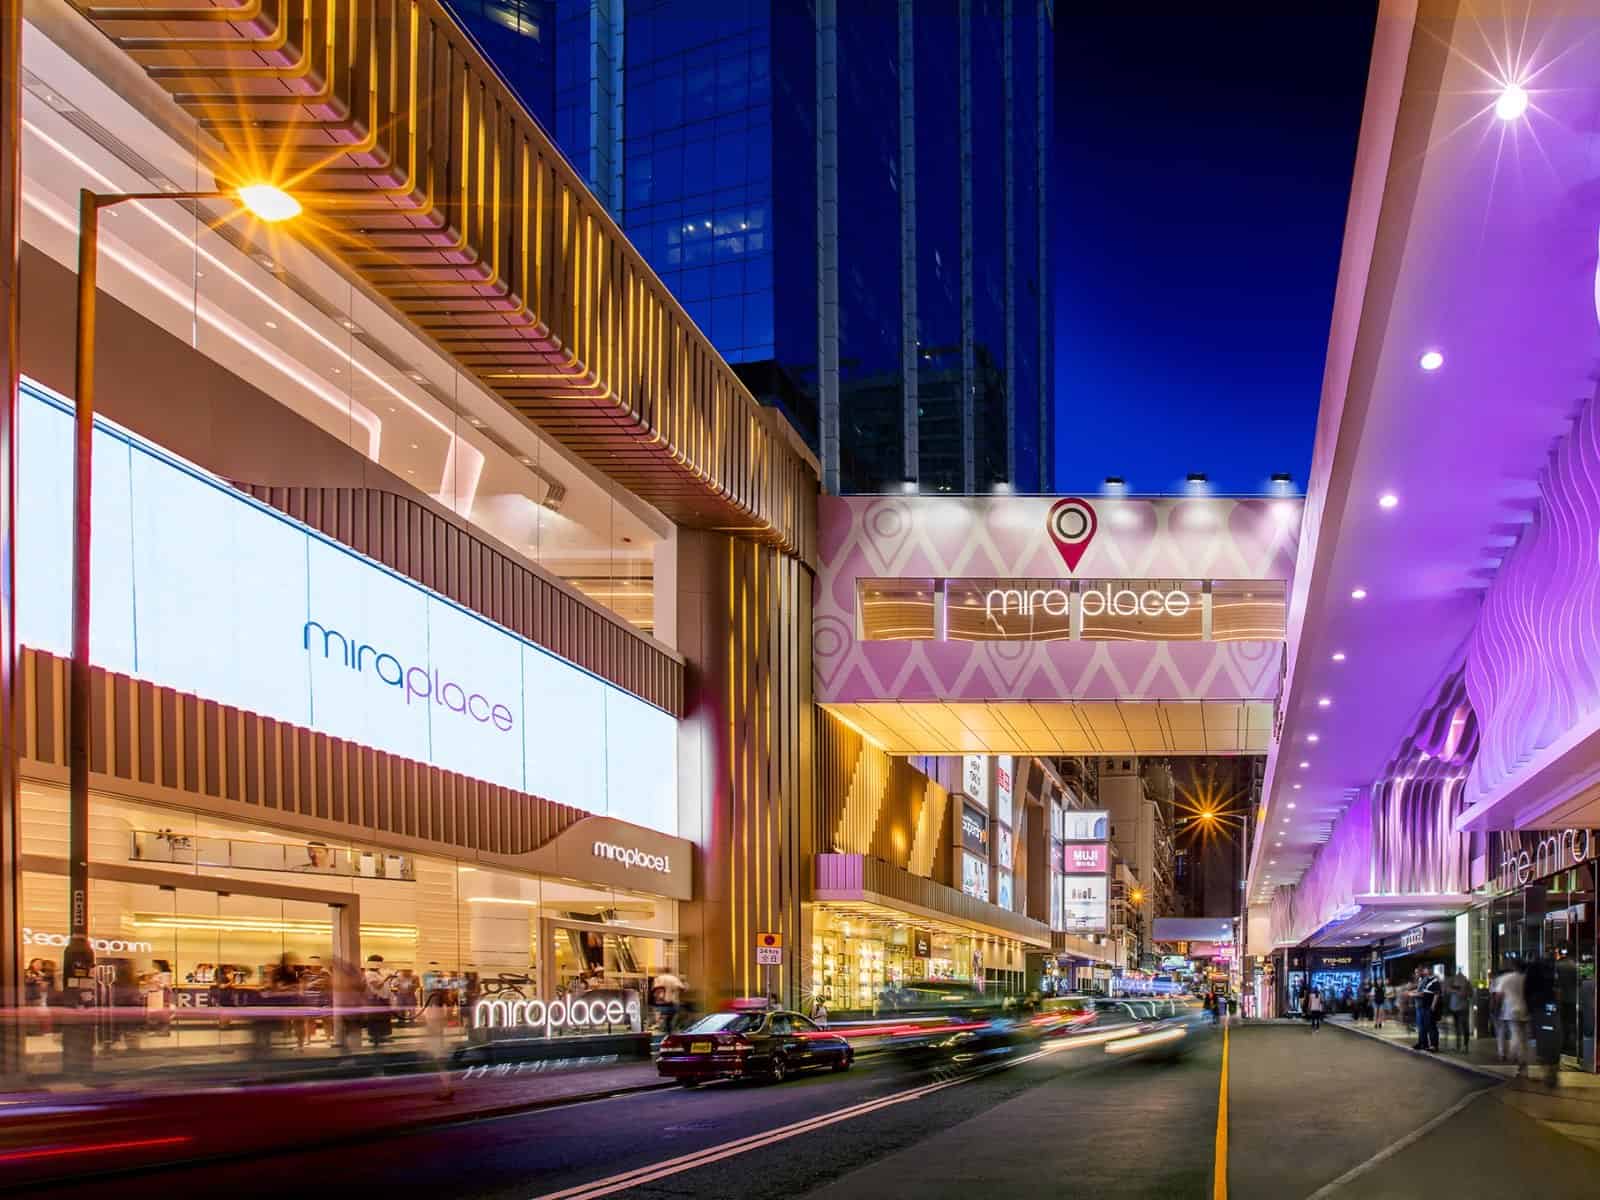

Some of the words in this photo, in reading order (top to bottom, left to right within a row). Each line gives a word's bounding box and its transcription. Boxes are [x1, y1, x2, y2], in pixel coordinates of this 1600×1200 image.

[986, 589, 1069, 617] mira
[1080, 583, 1190, 632] place
[304, 621, 513, 731] miraplace
[1073, 850, 1098, 861] MUJI
[1501, 848, 1530, 891] the
[1536, 828, 1590, 880] mira
